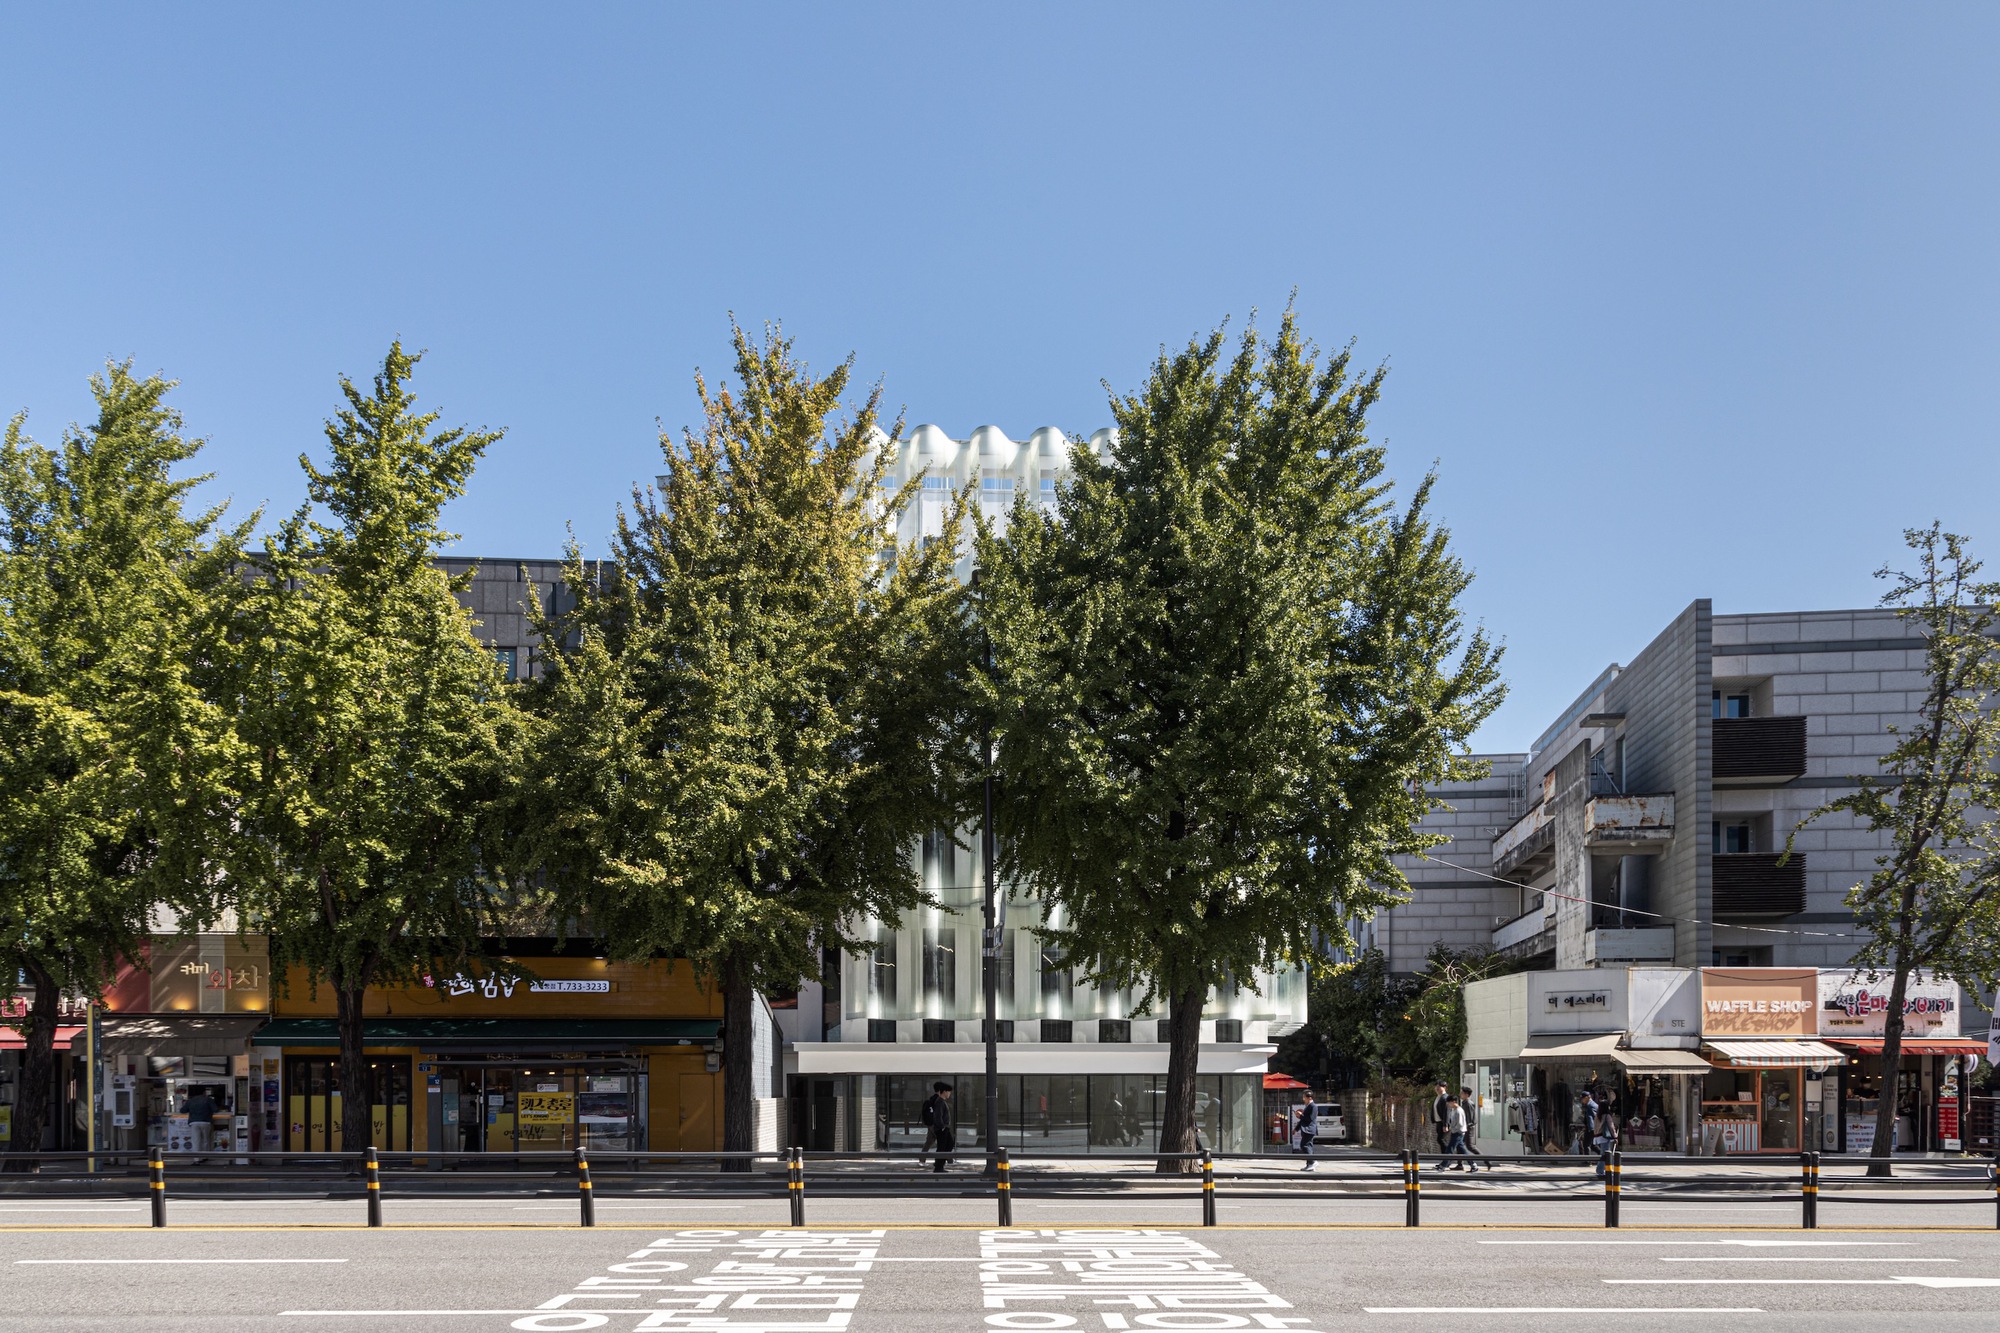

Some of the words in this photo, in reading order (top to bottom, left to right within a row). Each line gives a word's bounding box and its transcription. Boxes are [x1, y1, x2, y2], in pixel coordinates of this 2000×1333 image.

[557, 982, 608, 992] T.733-3233
[1706, 1000, 1767, 1013] WAFFLE
[1769, 1000, 1813, 1013] SHOP
